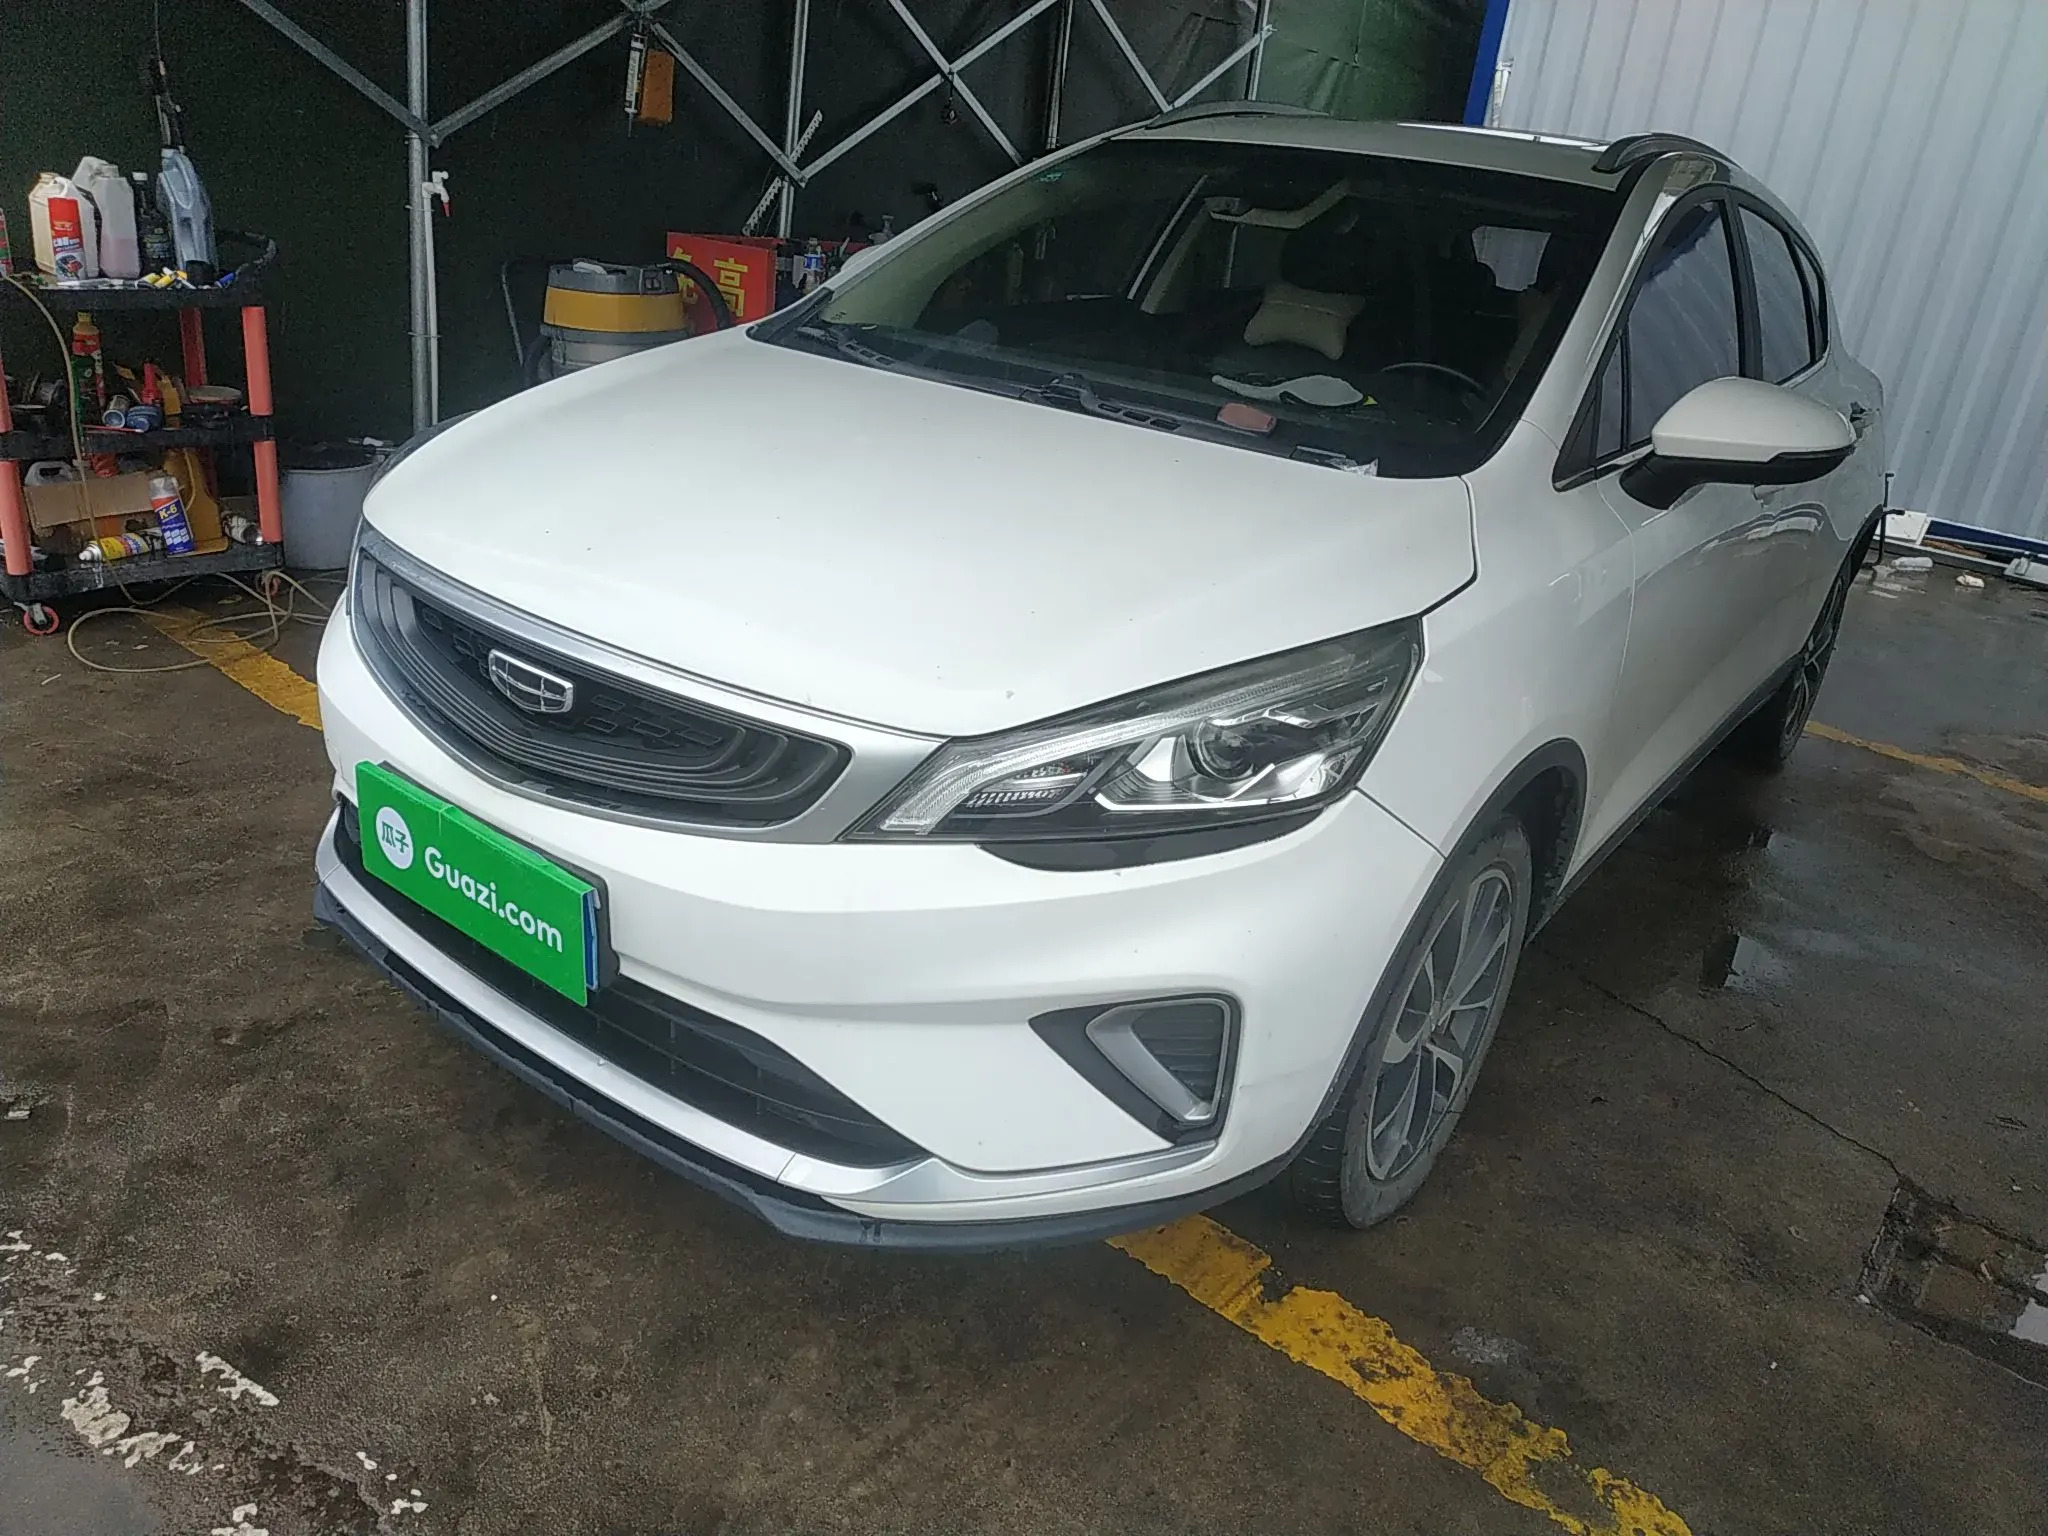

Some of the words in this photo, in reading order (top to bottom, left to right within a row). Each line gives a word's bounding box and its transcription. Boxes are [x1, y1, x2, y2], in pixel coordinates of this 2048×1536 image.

[159, 504, 177, 519] K-6
[381, 820, 410, 855] 瓜子
[424, 846, 563, 953] Guazi.com
